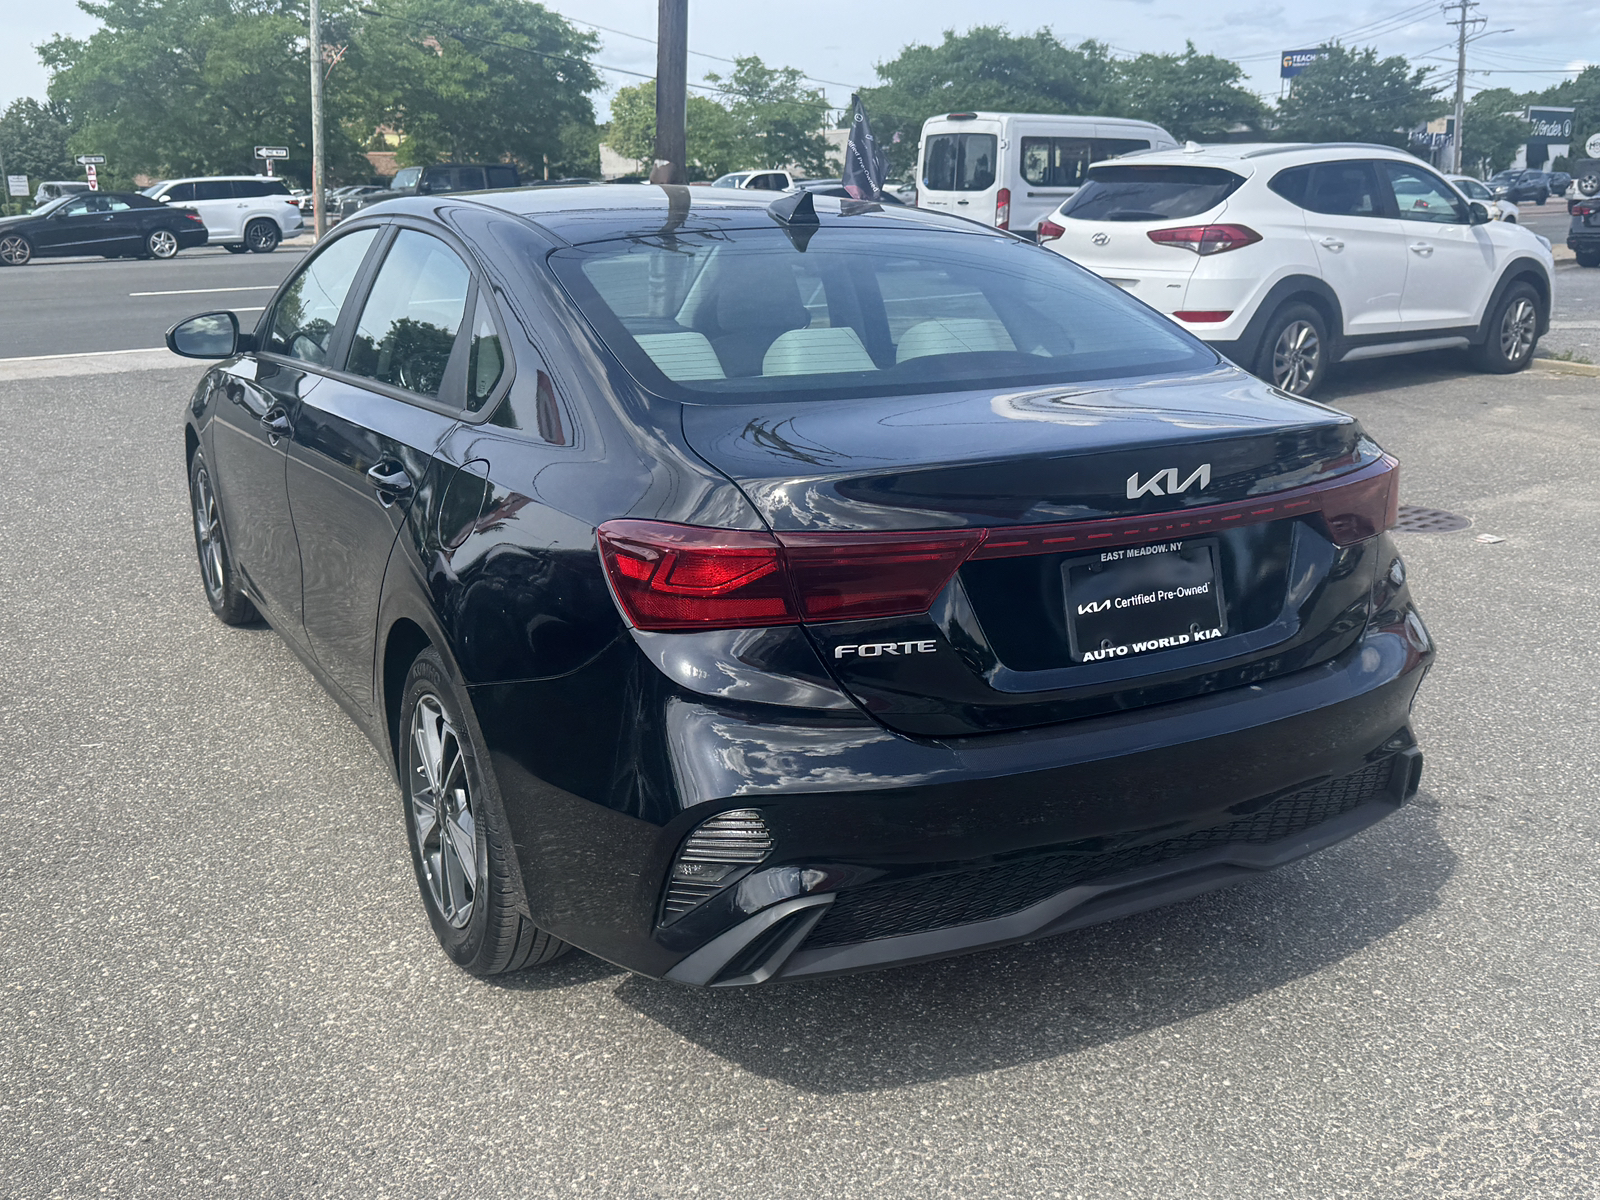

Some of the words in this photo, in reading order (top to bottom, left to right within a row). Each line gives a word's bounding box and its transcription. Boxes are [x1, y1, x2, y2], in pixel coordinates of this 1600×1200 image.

[1126, 463, 1211, 500] KIA
[1100, 551, 1124, 562] EAST
[1170, 541, 1183, 551] NY
[1077, 599, 1111, 615] KIA
[1114, 591, 1155, 609] Certified
[1158, 583, 1209, 601] Pre-Owned
[834, 639, 937, 659] FORTE
[1082, 645, 1129, 663] AUTO
[1132, 634, 1190, 653] WORLD
[1194, 628, 1222, 642] KIA
